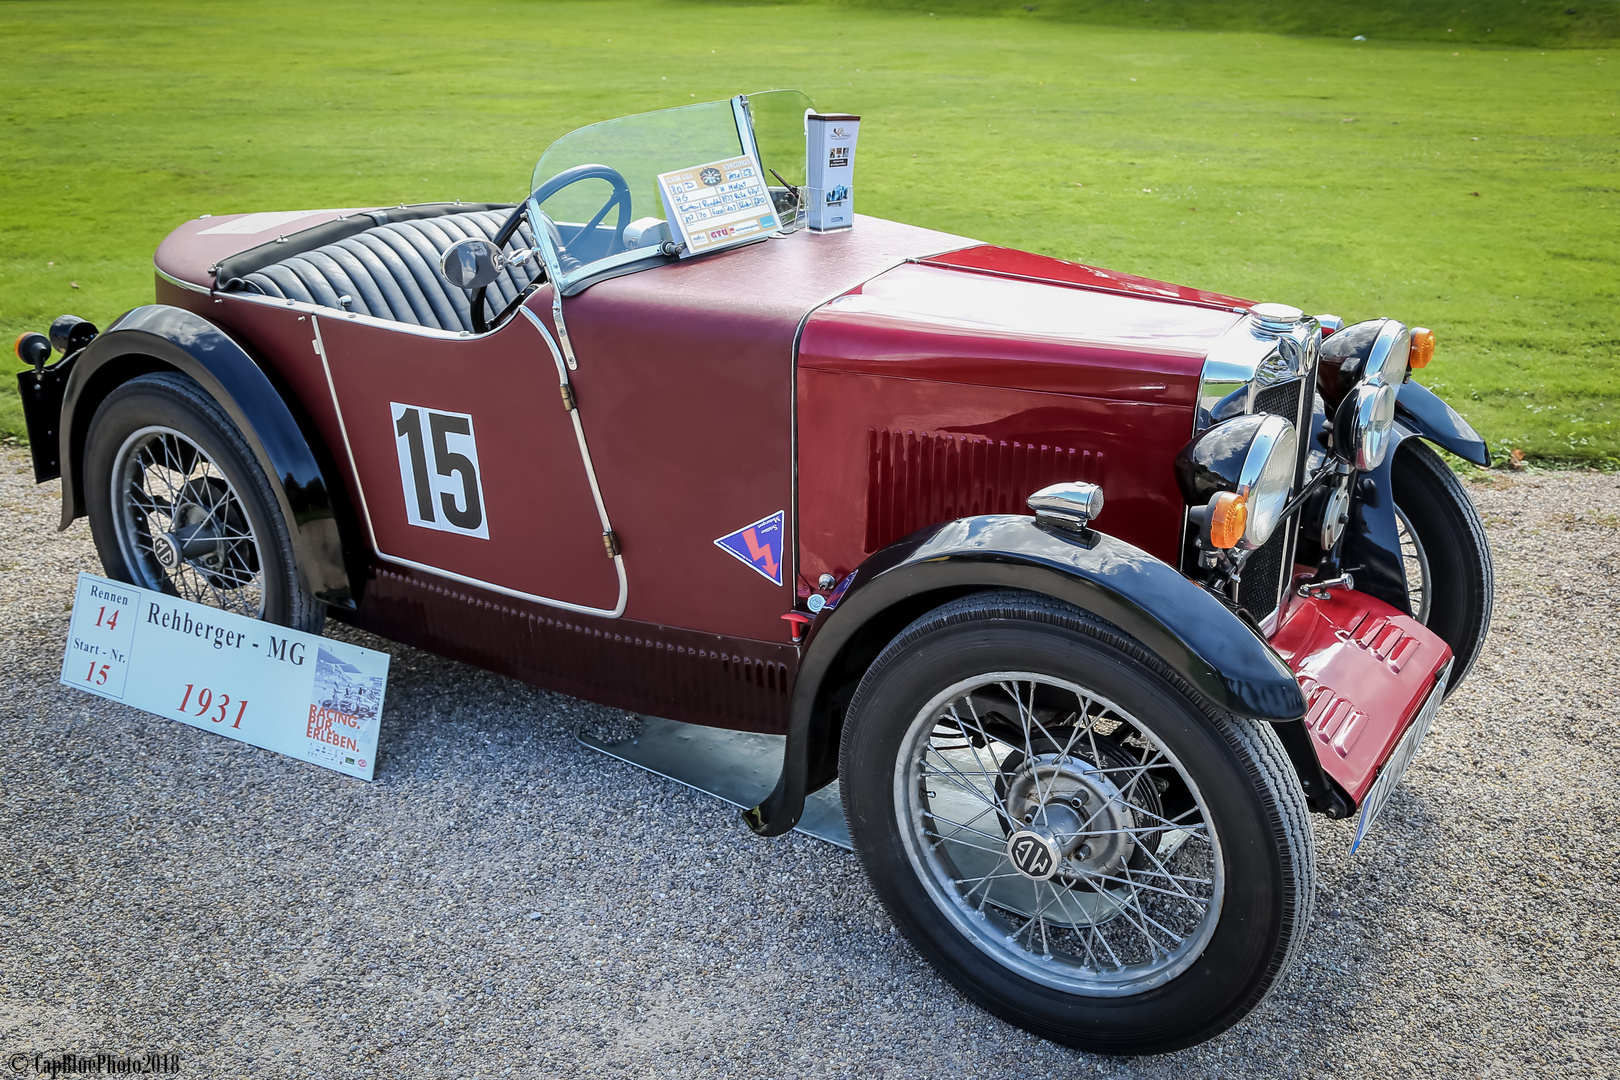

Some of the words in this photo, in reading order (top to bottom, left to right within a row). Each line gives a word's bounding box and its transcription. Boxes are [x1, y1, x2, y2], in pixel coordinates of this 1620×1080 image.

[710, 227, 728, 238] GTÜ
[396, 407, 482, 530] 15
[156, 540, 172, 564] MG
[90, 585, 128, 606] Rennen
[94, 606, 120, 630] 14
[146, 602, 246, 649] Rehberger
[267, 636, 306, 666] MG
[74, 638, 99, 655] Start
[110, 649, 126, 664] Nr.
[84, 661, 110, 686] 15
[176, 684, 248, 730] 1931
[309, 704, 360, 730] RACING.
[306, 726, 360, 752] ERLEBEN.
[308, 716, 335, 736] PUR.
[1016, 840, 1048, 872] MG
